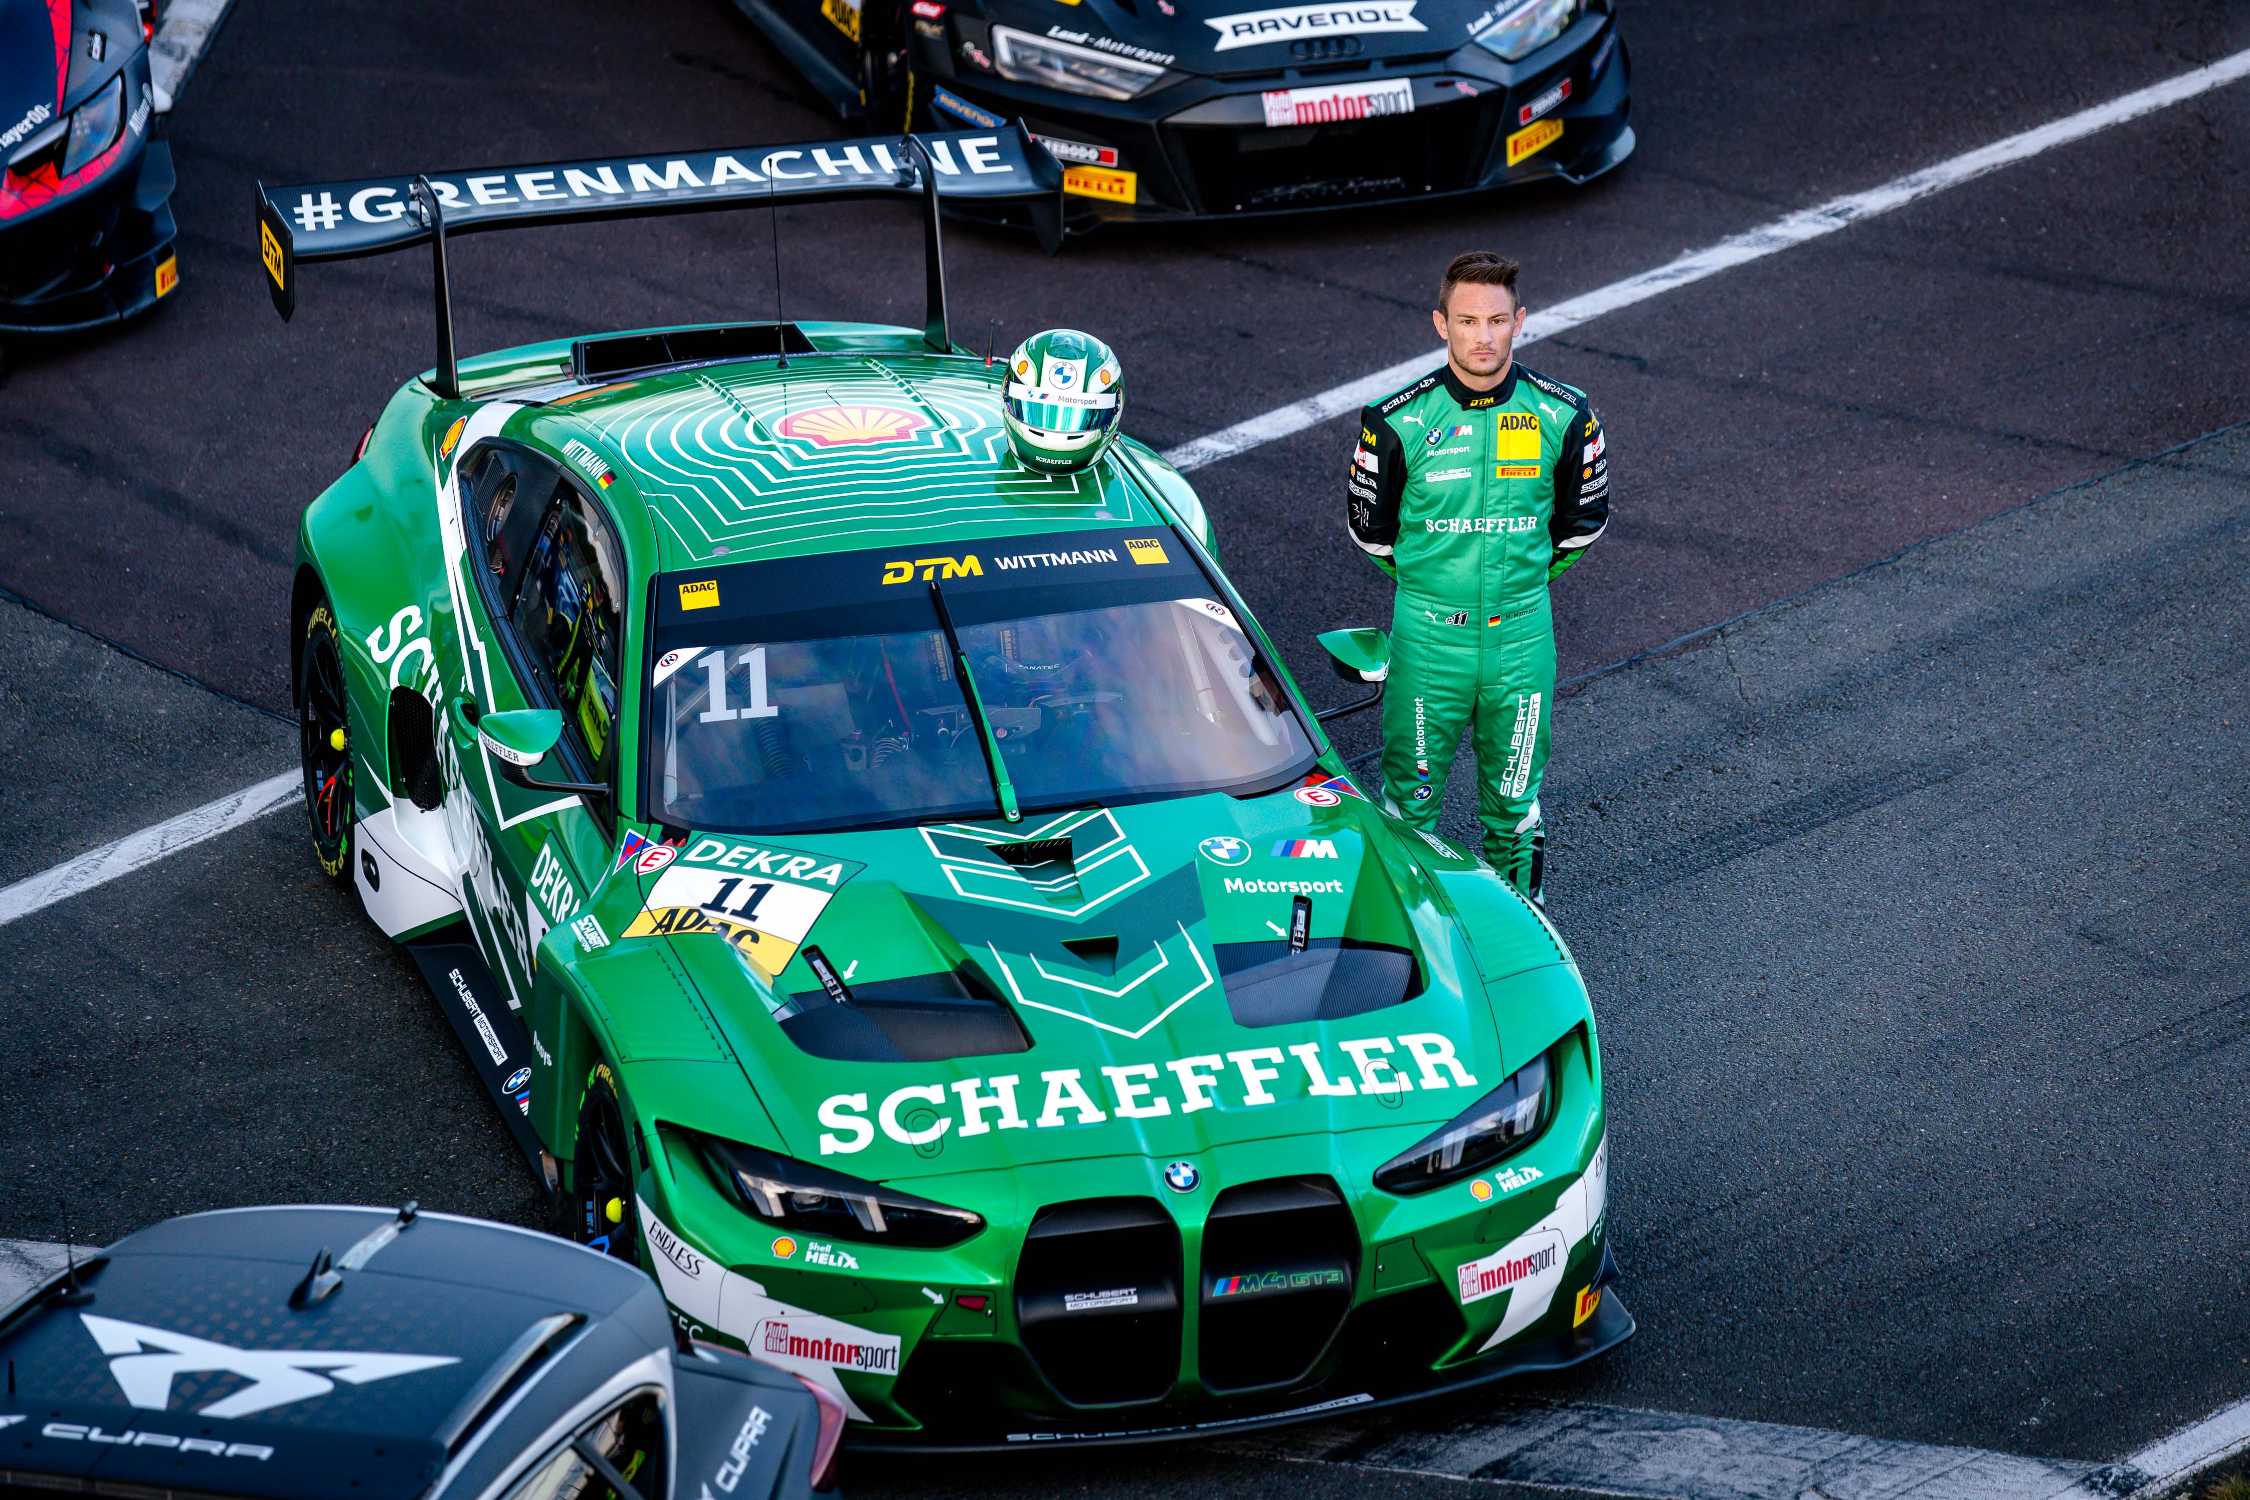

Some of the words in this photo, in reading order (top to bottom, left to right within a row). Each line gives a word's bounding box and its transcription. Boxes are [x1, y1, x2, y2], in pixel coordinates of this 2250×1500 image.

[1230, 9, 1404, 38] RAVENOL
[1295, 88, 1409, 125] motorsport
[294, 136, 1013, 232] #GREENMACHINE
[1057, 394, 1097, 406] Motorsport
[1469, 396, 1495, 407] DTM
[1499, 415, 1539, 431] ADAC
[561, 438, 610, 481] WITTMANN
[1035, 454, 1073, 465] SCHAEFFLER
[1426, 446, 1470, 458] Motorsport
[1500, 468, 1537, 477] PIRELLI
[1425, 516, 1538, 534] SCHAEFFLER
[1127, 537, 1160, 552] ADAC
[881, 554, 985, 586] DTM
[993, 548, 1118, 571] WITTMANN
[681, 581, 716, 596] ADAC
[697, 646, 779, 724] 11
[1414, 696, 1425, 756] Motorsport
[1500, 694, 1529, 797] SCHUBERT
[1516, 700, 1540, 794] MOTORSPORT
[683, 839, 844, 886] DEKRA
[530, 842, 582, 926] DEKRA
[700, 877, 775, 923] 11
[1223, 877, 1344, 897] Motorsport
[649, 907, 760, 955] ADAC
[448, 968, 482, 1018] SCHUBERT
[476, 1014, 507, 1064] MOTORSPORT
[816, 1032, 1479, 1156] SCHAEFFLER
[1501, 1166, 1545, 1193] HELIX
[649, 1221, 706, 1277] ENDLESS
[804, 1250, 860, 1270] HELIX
[808, 1241, 832, 1253] Shell
[1479, 1242, 1556, 1293] motorsport
[1064, 1287, 1137, 1301] SCHUBERT
[1068, 1297, 1137, 1310] MOTORSPORT
[789, 1335, 898, 1371] motorsport
[41, 1422, 275, 1461] CUPRA
[716, 1405, 774, 1494] CUPRA
